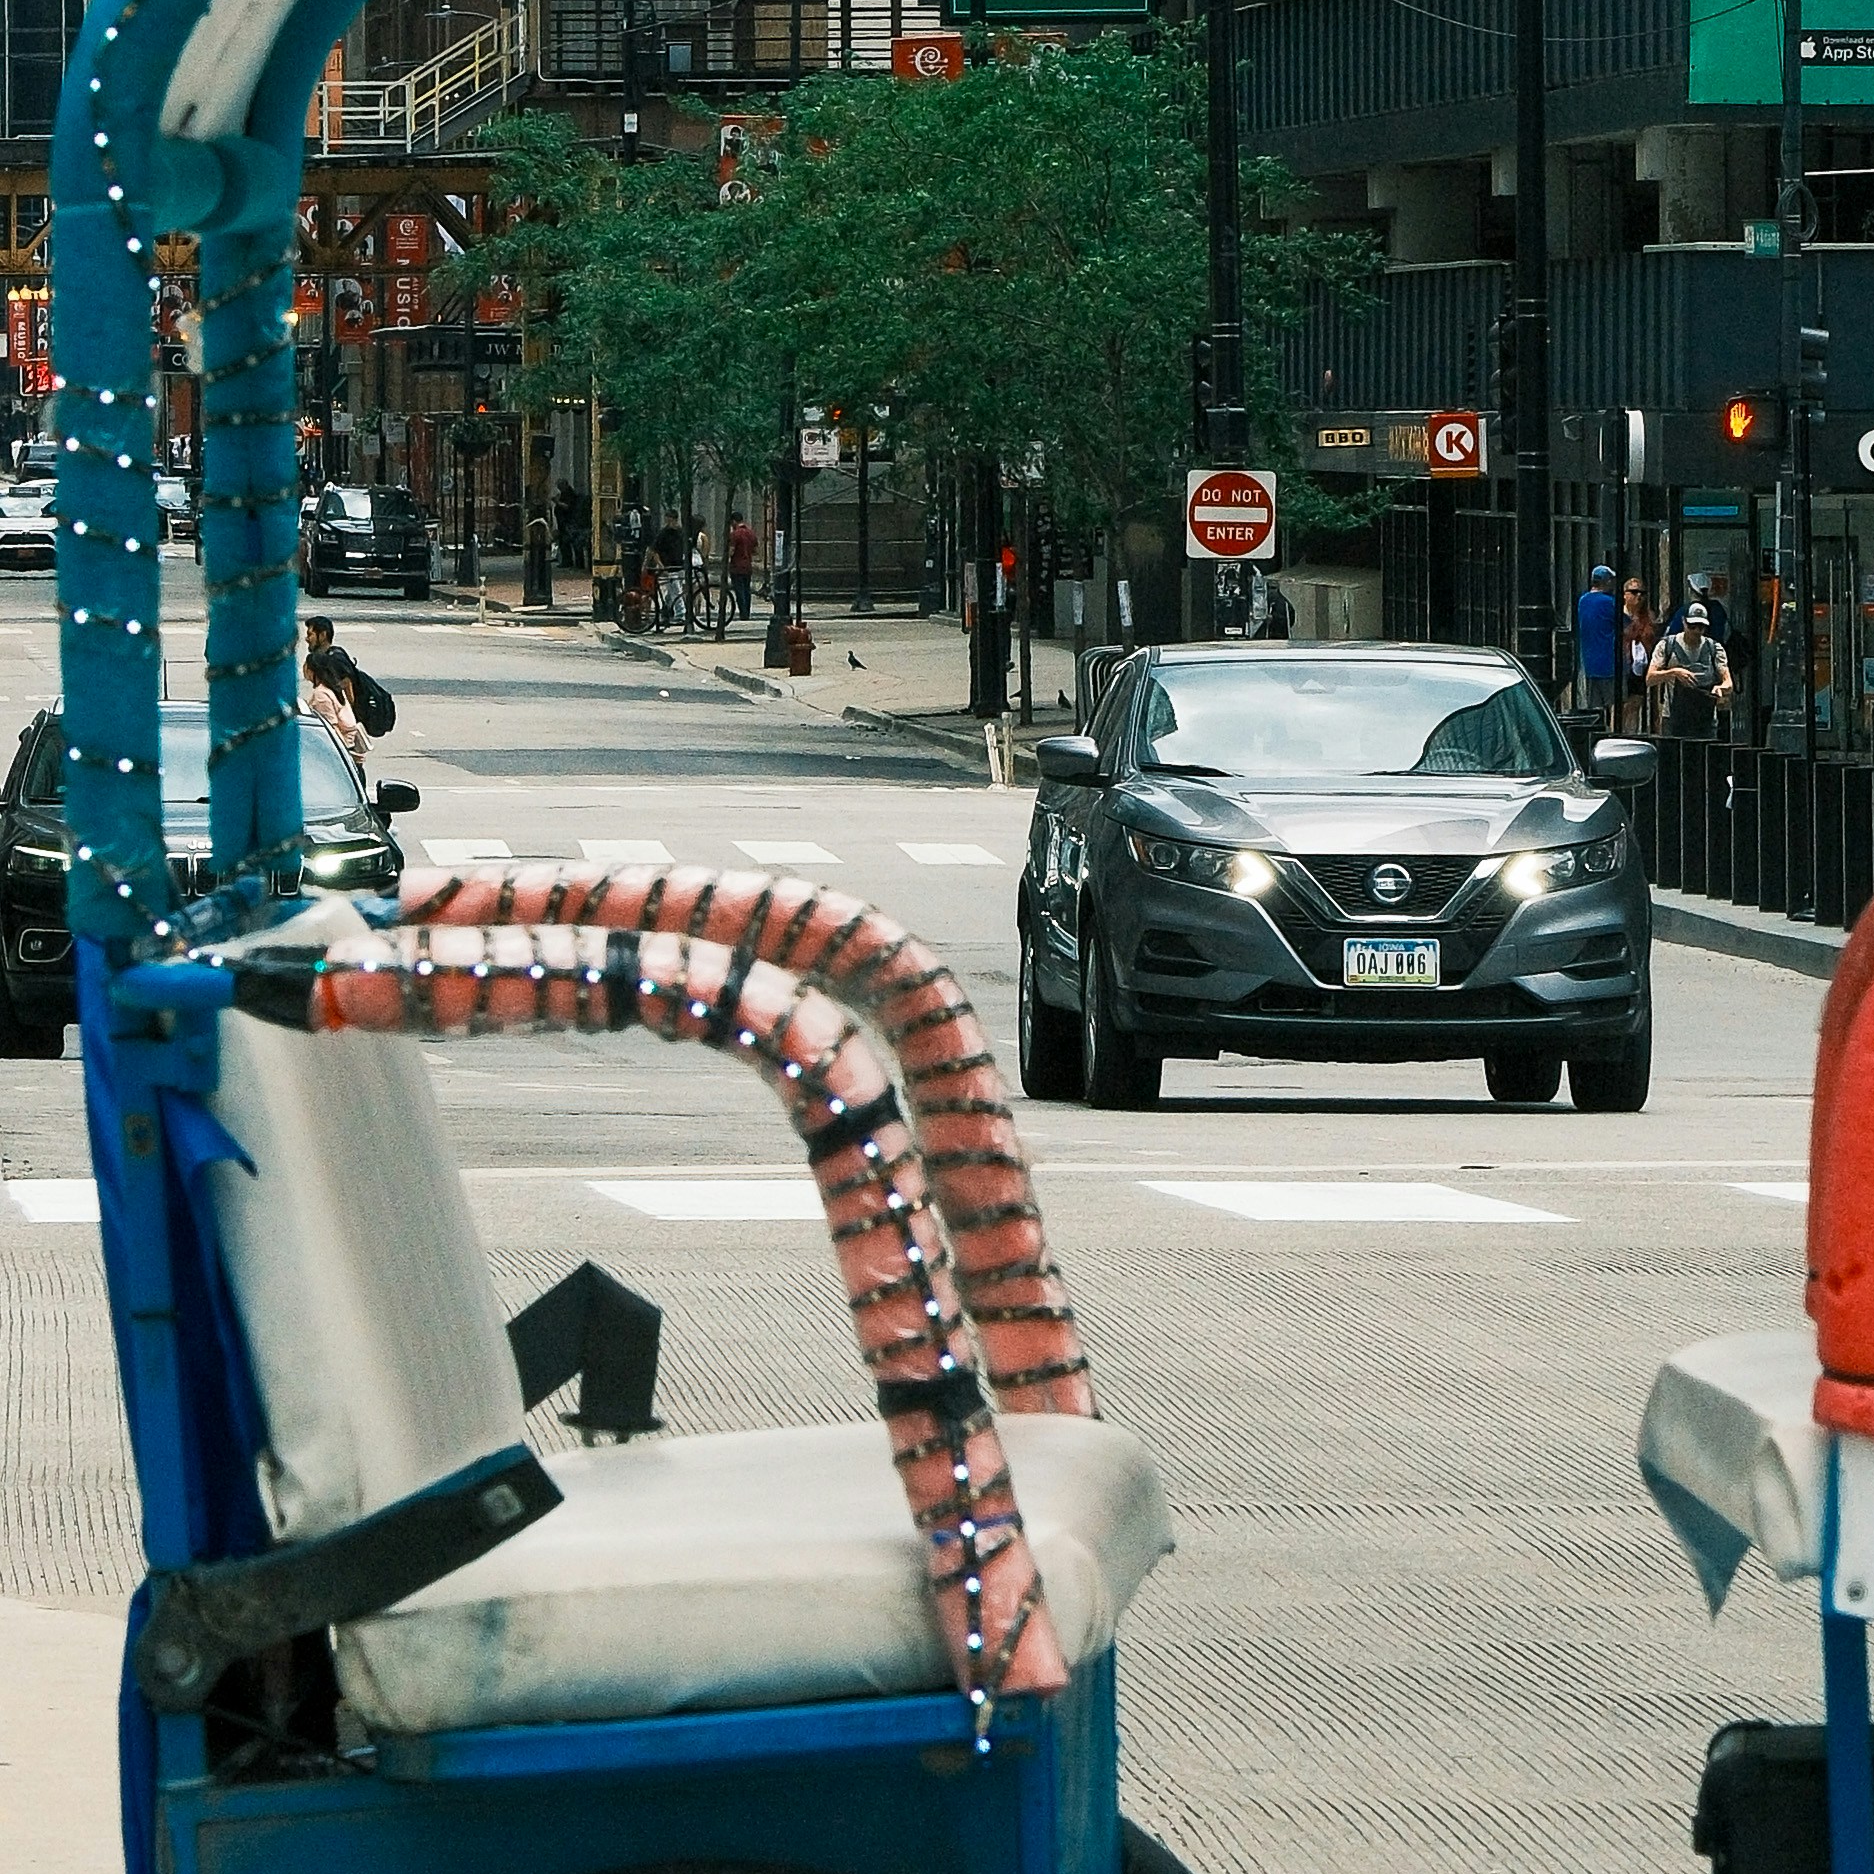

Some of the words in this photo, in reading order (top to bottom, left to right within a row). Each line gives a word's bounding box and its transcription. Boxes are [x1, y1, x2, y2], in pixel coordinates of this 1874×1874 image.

[1822, 46, 1853, 62] App
[1445, 430, 1472, 460] K
[1201, 488, 1222, 502] DO
[1231, 489, 1262, 503] NOT
[1206, 526, 1255, 541] ENTER
